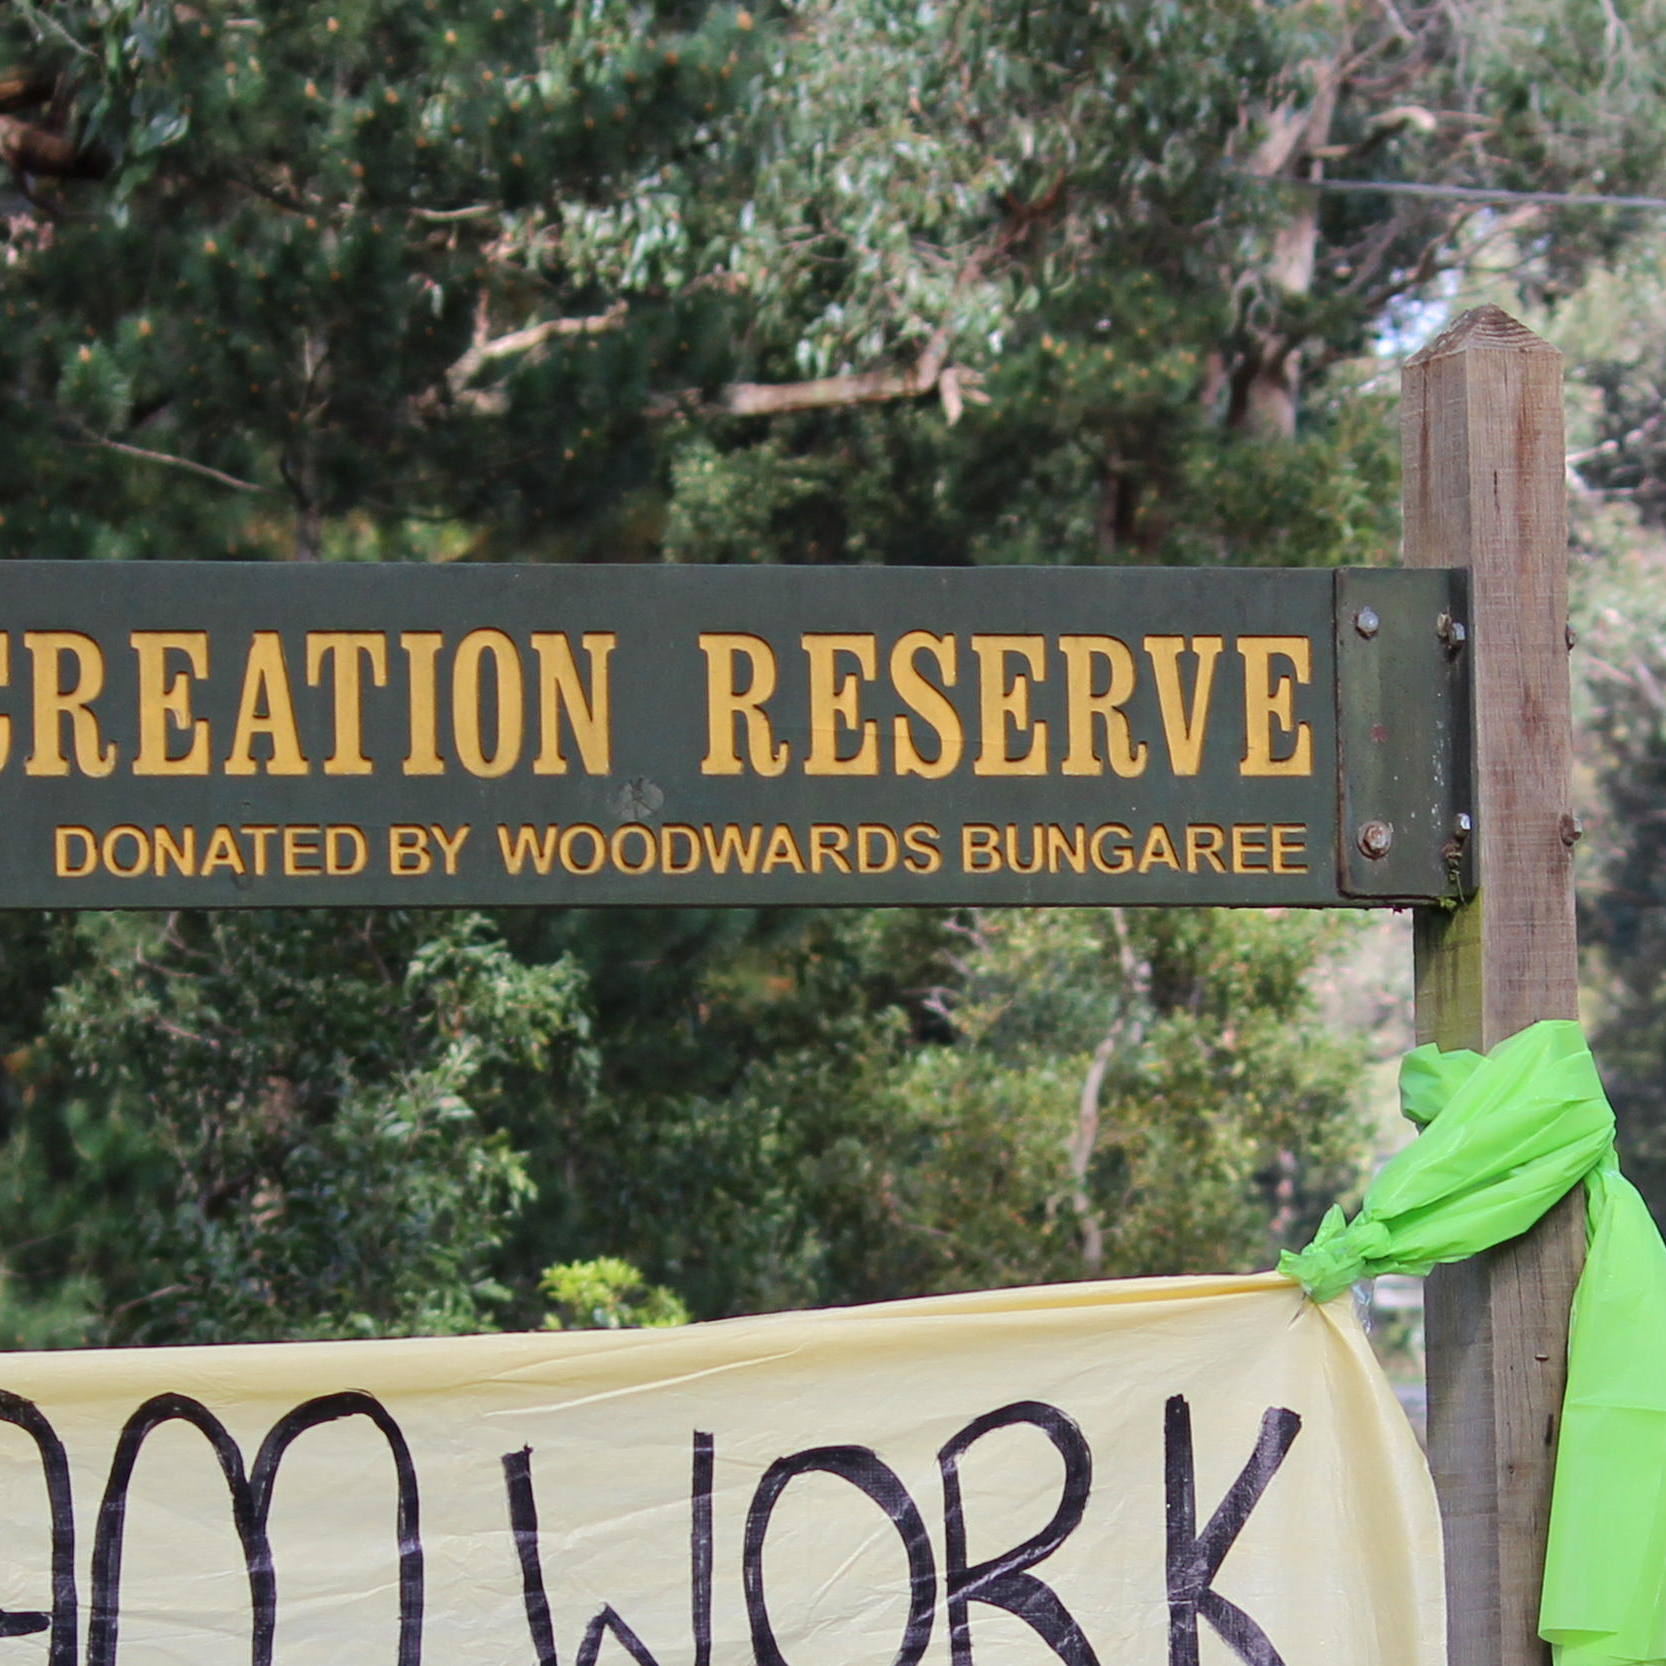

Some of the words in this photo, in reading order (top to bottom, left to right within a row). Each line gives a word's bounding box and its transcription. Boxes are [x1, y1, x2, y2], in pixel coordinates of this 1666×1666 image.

[696, 630, 1314, 781] RESERVE
[53, 825, 369, 878] DONATED
[388, 826, 471, 876] BY
[495, 823, 943, 876] WOODWARDS
[960, 824, 1309, 876] BUNGAREE
